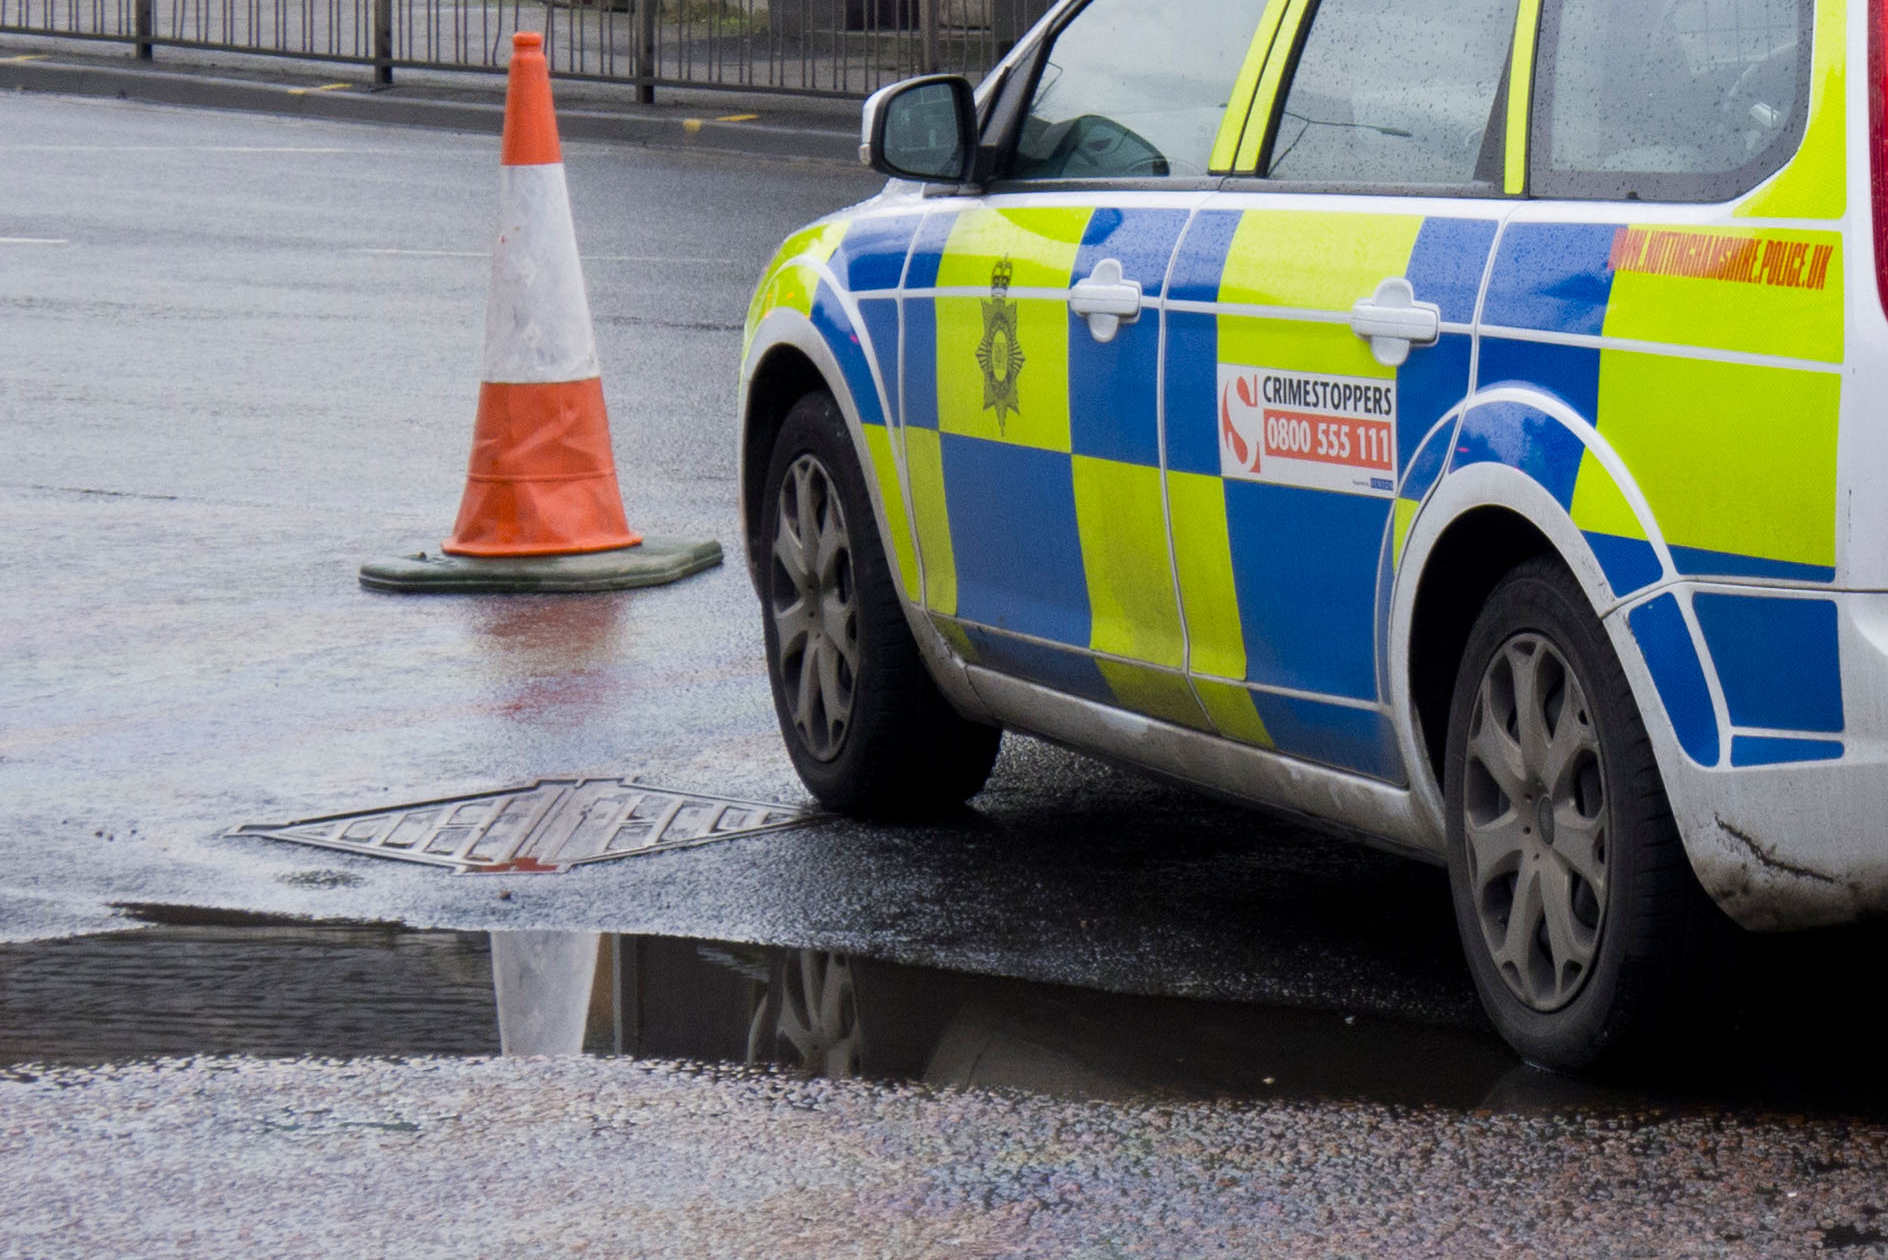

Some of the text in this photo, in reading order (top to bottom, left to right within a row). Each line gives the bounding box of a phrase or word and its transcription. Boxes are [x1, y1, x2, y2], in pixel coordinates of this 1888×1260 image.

[1263, 375, 1392, 416] CRIMESTOPPERS
[1267, 416, 1389, 463] 0800 555 111
